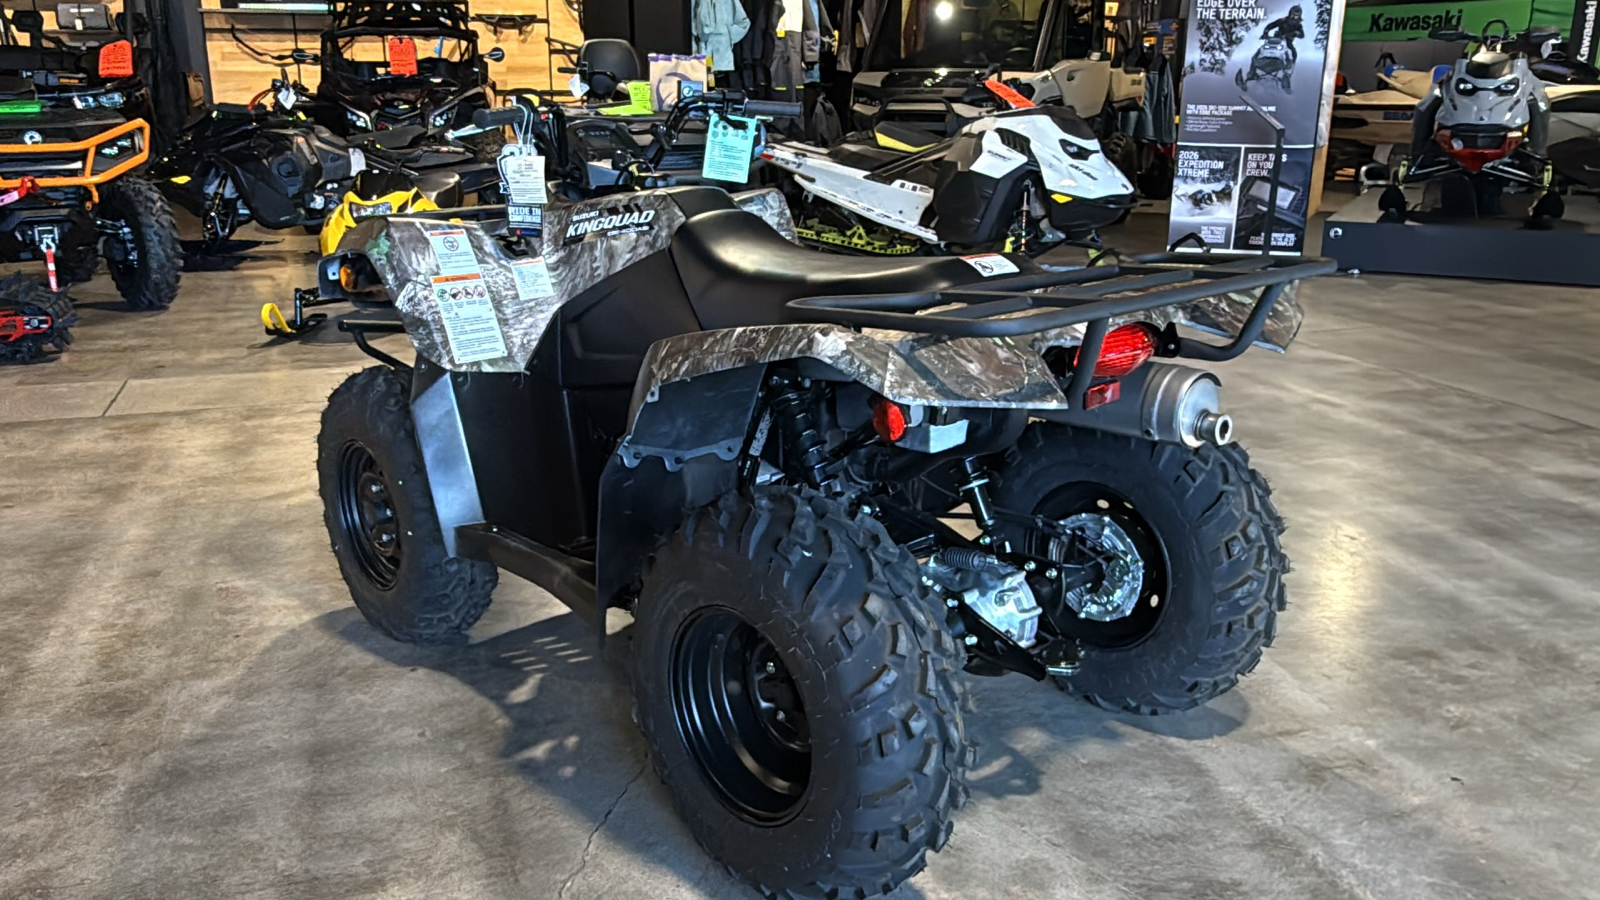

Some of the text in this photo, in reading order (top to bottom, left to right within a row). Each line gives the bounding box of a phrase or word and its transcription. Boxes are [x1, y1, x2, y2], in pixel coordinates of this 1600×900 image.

[1227, 0, 1256, 8] OVER
[1196, 8, 1267, 19] THE TERRAIN.
[1370, 9, 1463, 32] Kawasaki
[1577, 0, 1598, 63] Kawasaki
[1179, 151, 1199, 160] 2026
[1248, 153, 1267, 161] KEEP
[1178, 159, 1224, 169] EXPEDITION
[1247, 161, 1257, 169] ON
[1177, 168, 1210, 177] XTREME
[1246, 169, 1270, 177] CREW.
[508, 206, 541, 216] RIDE IN
[508, 214, 541, 223] CONFIDENCE
[572, 210, 600, 222] SUZUKI
[565, 209, 656, 238] KINGQUAD
